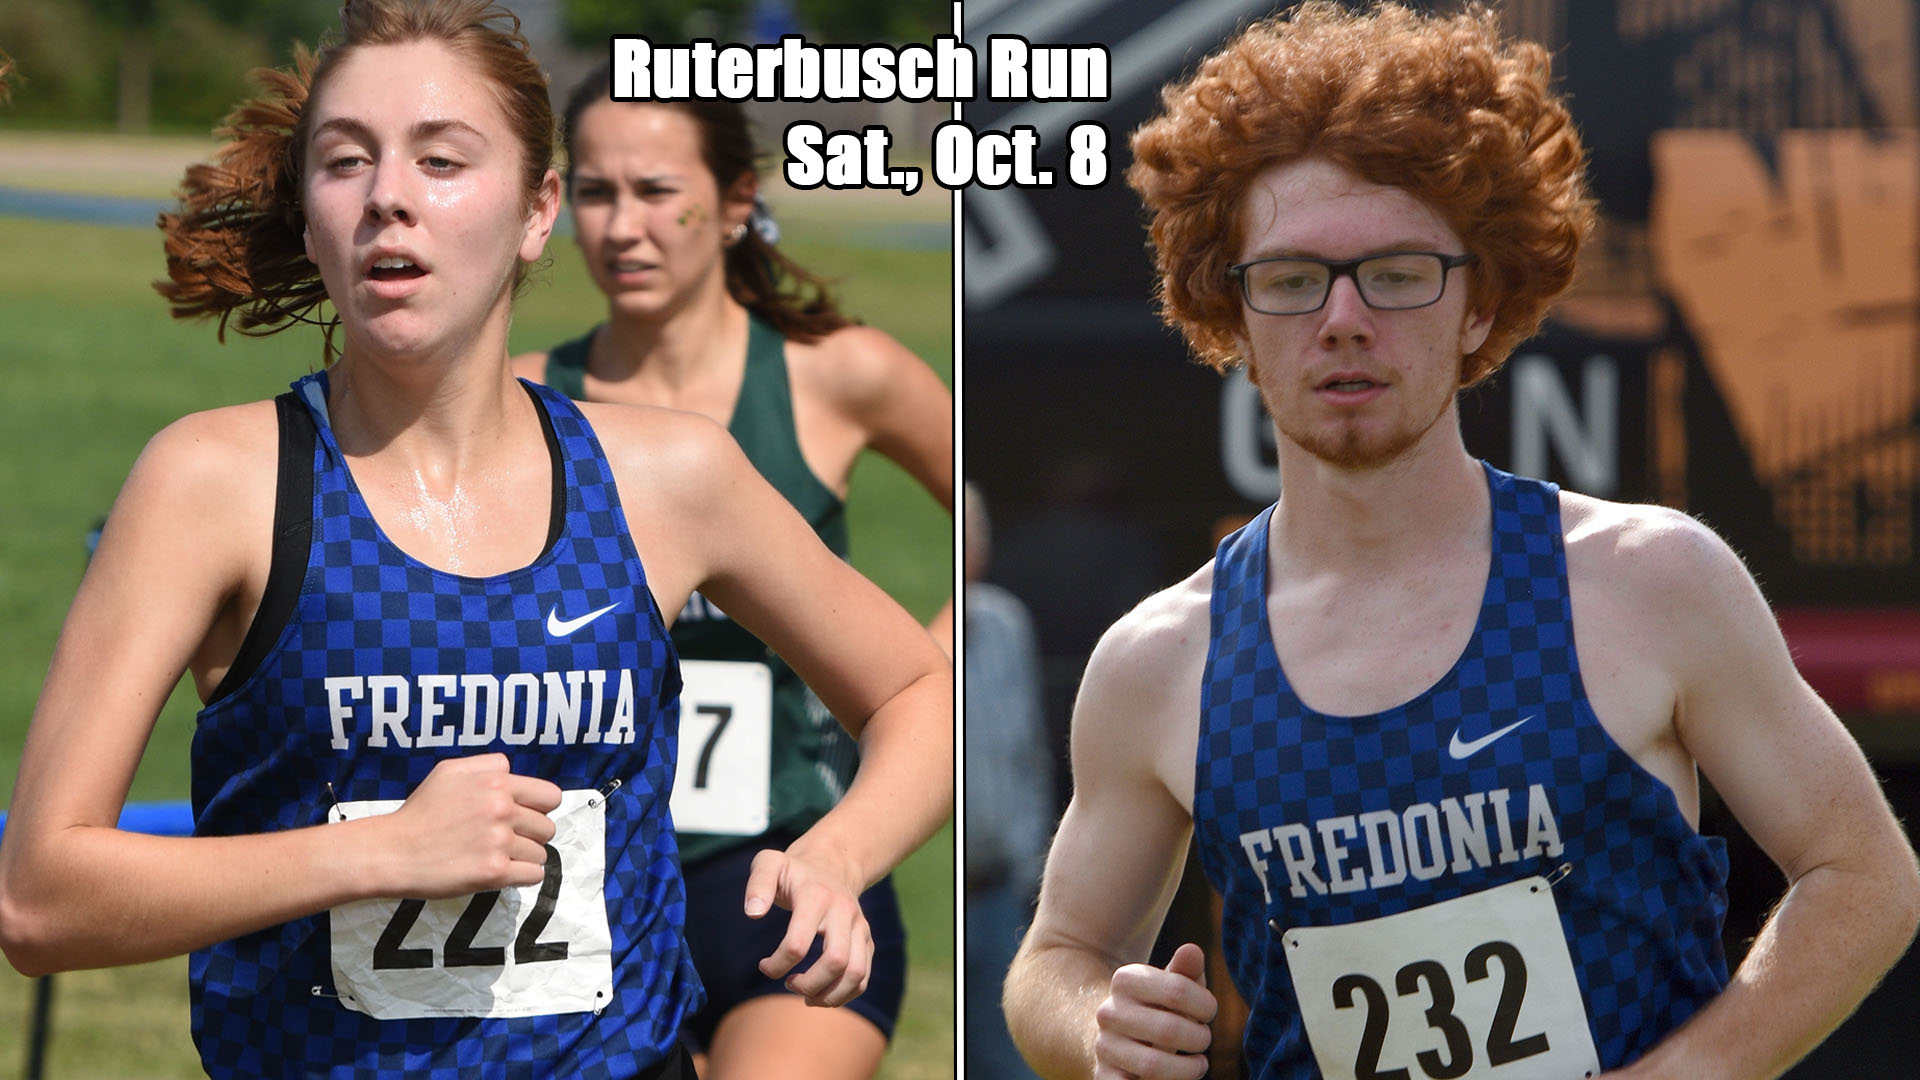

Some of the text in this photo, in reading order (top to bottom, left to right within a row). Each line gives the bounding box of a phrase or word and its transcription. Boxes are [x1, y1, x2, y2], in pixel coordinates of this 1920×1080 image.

[324, 669, 636, 750] FREDONIA
[1239, 783, 1565, 904] FREDONIA
[1331, 940, 1551, 1080] 232
